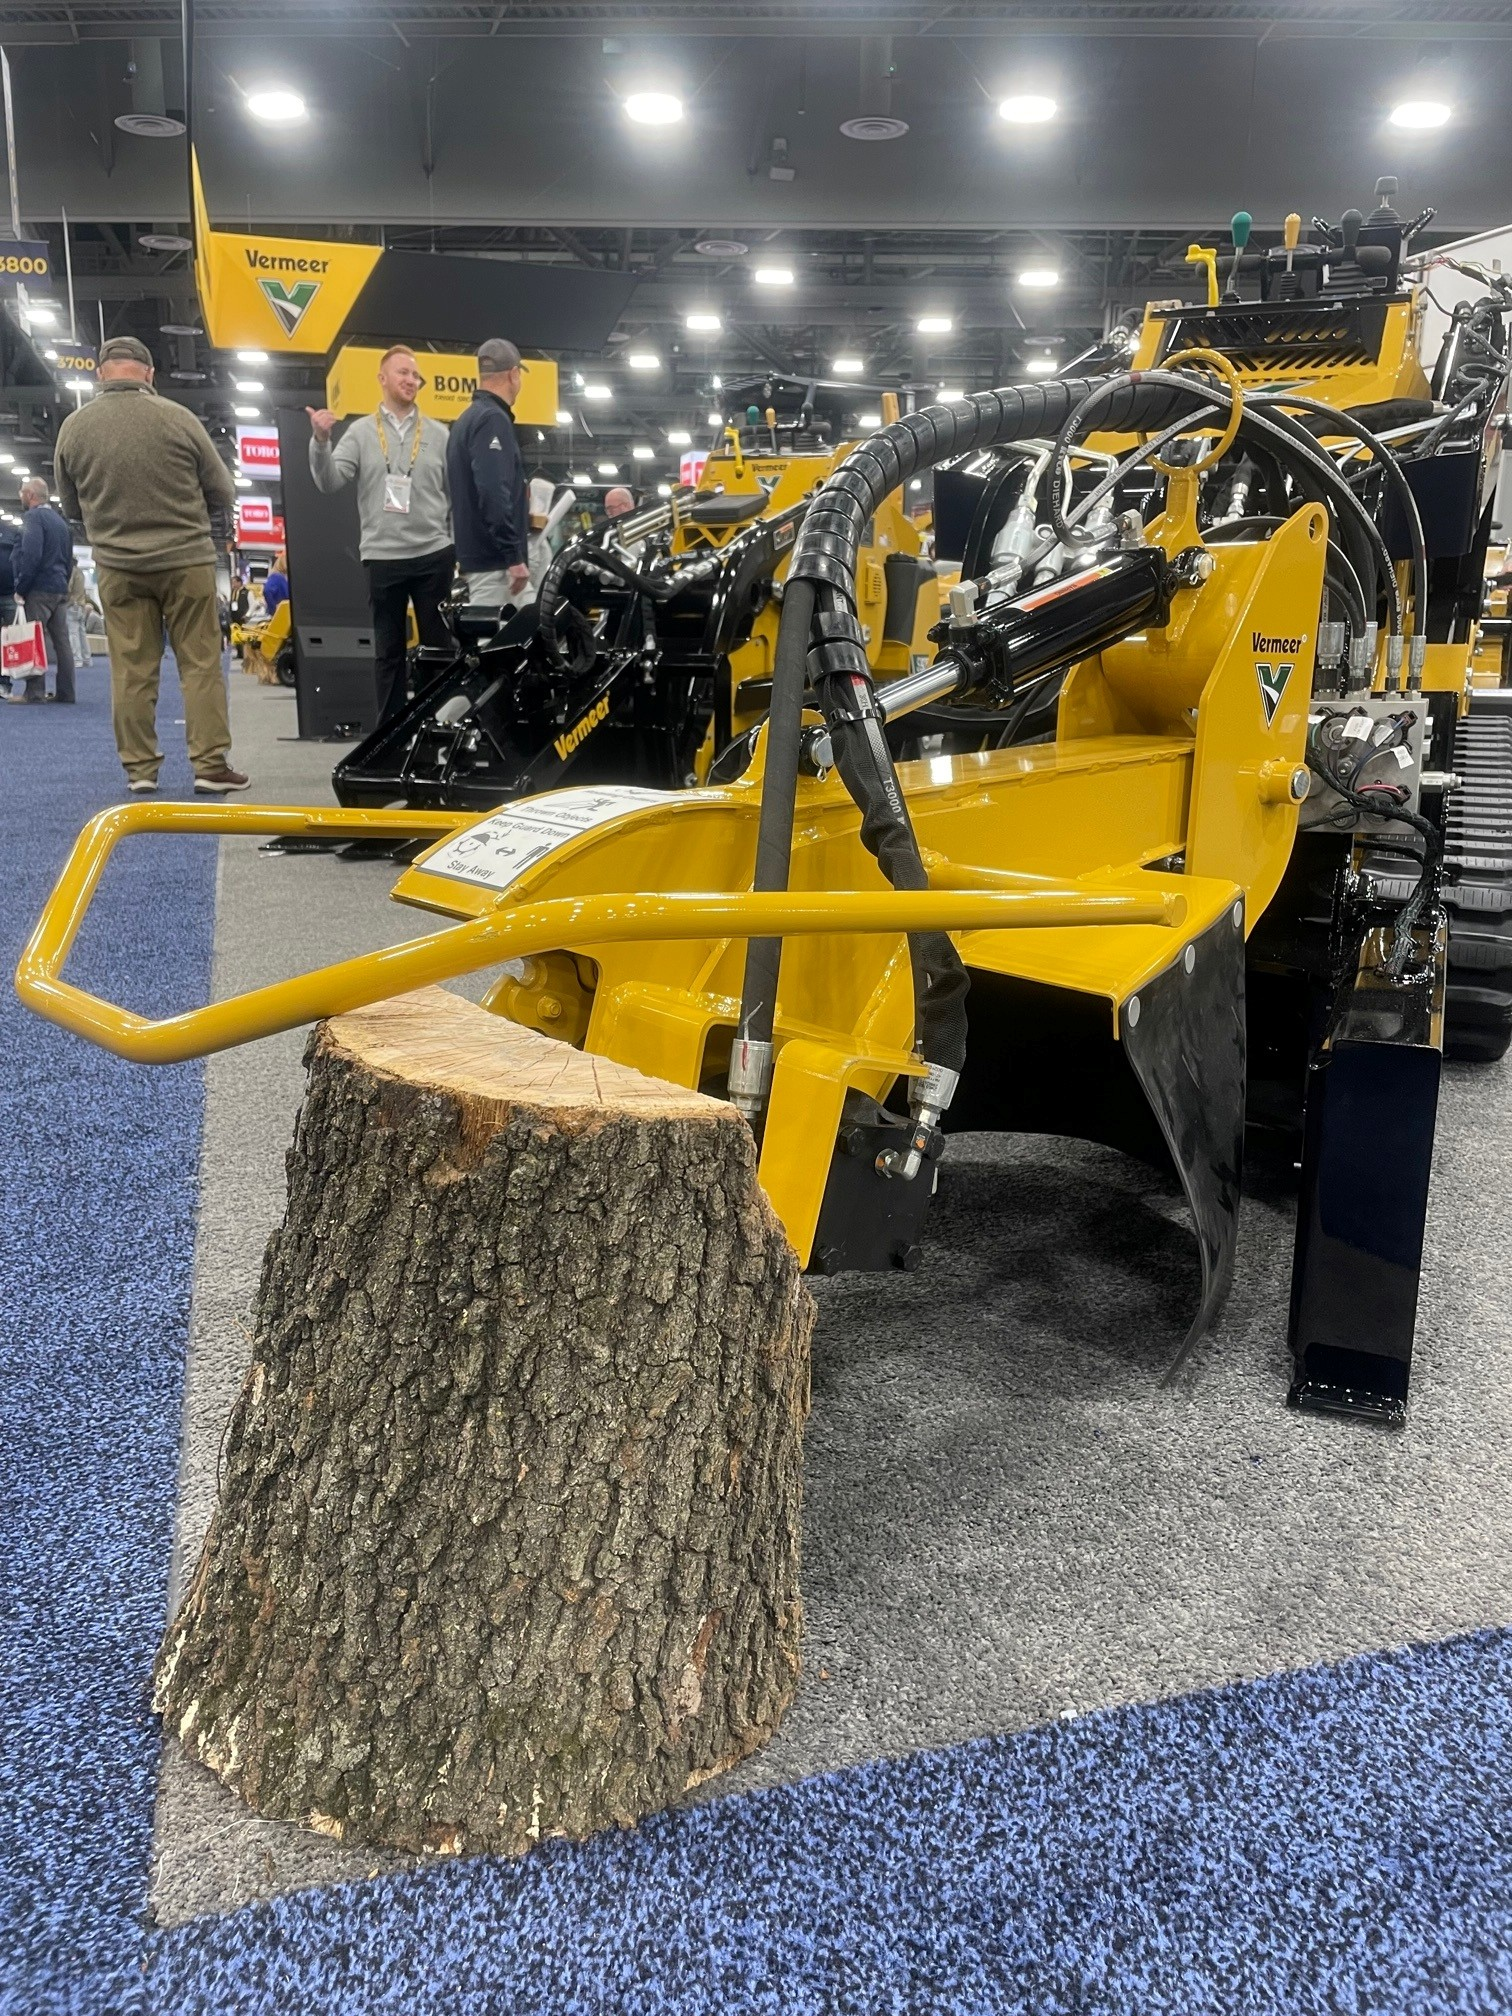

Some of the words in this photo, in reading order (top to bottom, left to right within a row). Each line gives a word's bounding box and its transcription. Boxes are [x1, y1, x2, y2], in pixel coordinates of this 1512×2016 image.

[245, 249, 329, 273] Vermeer
[57, 356, 96, 371] 3700
[434, 375, 477, 393] BOM
[1065, 415, 1082, 444] T3000
[243, 444, 280, 458] TORO
[1052, 480, 1064, 529] DIEHARD
[1252, 632, 1301, 654] Vermeer
[554, 696, 610, 761] Vermeer
[883, 778, 901, 814] T3000
[488, 818, 513, 829] Keep
[512, 822, 542, 834] Guard
[540, 826, 570, 839] Down
[447, 859, 469, 873] Stay
[466, 864, 496, 880] Away
